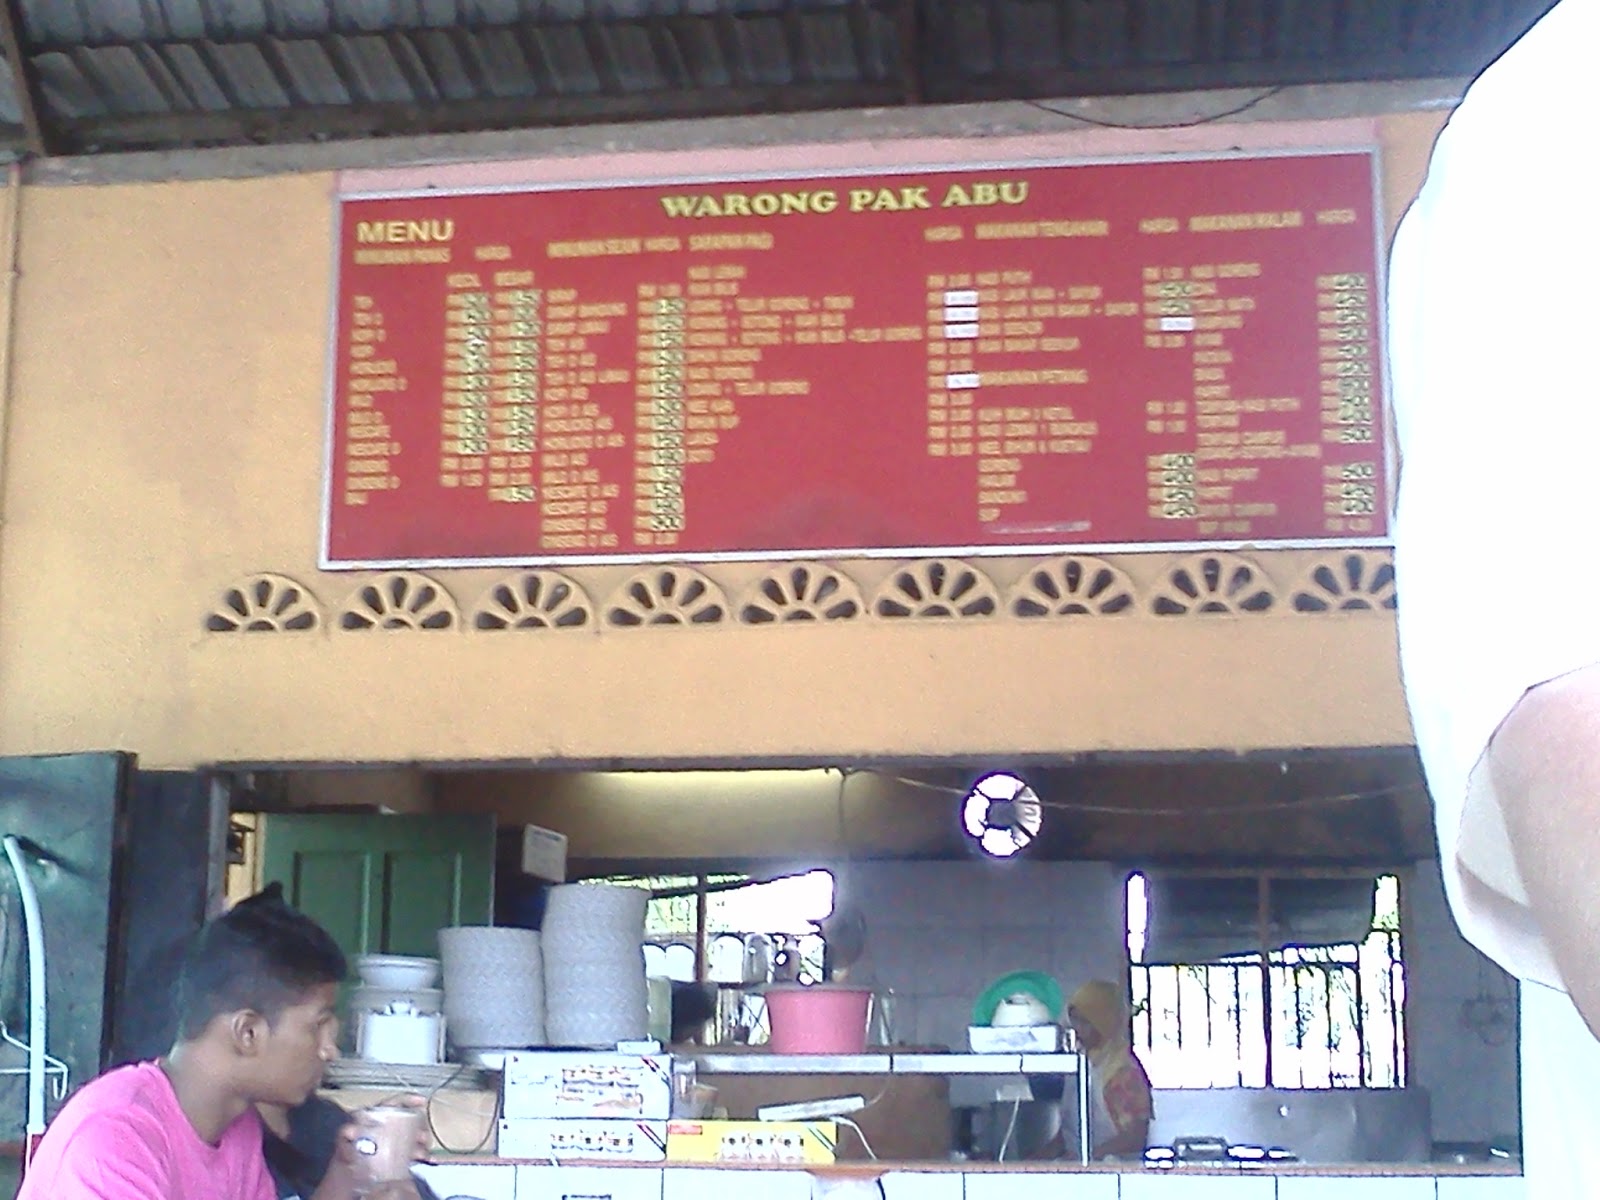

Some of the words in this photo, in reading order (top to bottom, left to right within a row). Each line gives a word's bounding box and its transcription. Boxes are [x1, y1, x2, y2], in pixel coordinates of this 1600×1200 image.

[661, 190, 837, 217] WARONG
[849, 187, 930, 211] PAK
[942, 181, 1029, 208] ABU
[356, 219, 455, 245] MENU
